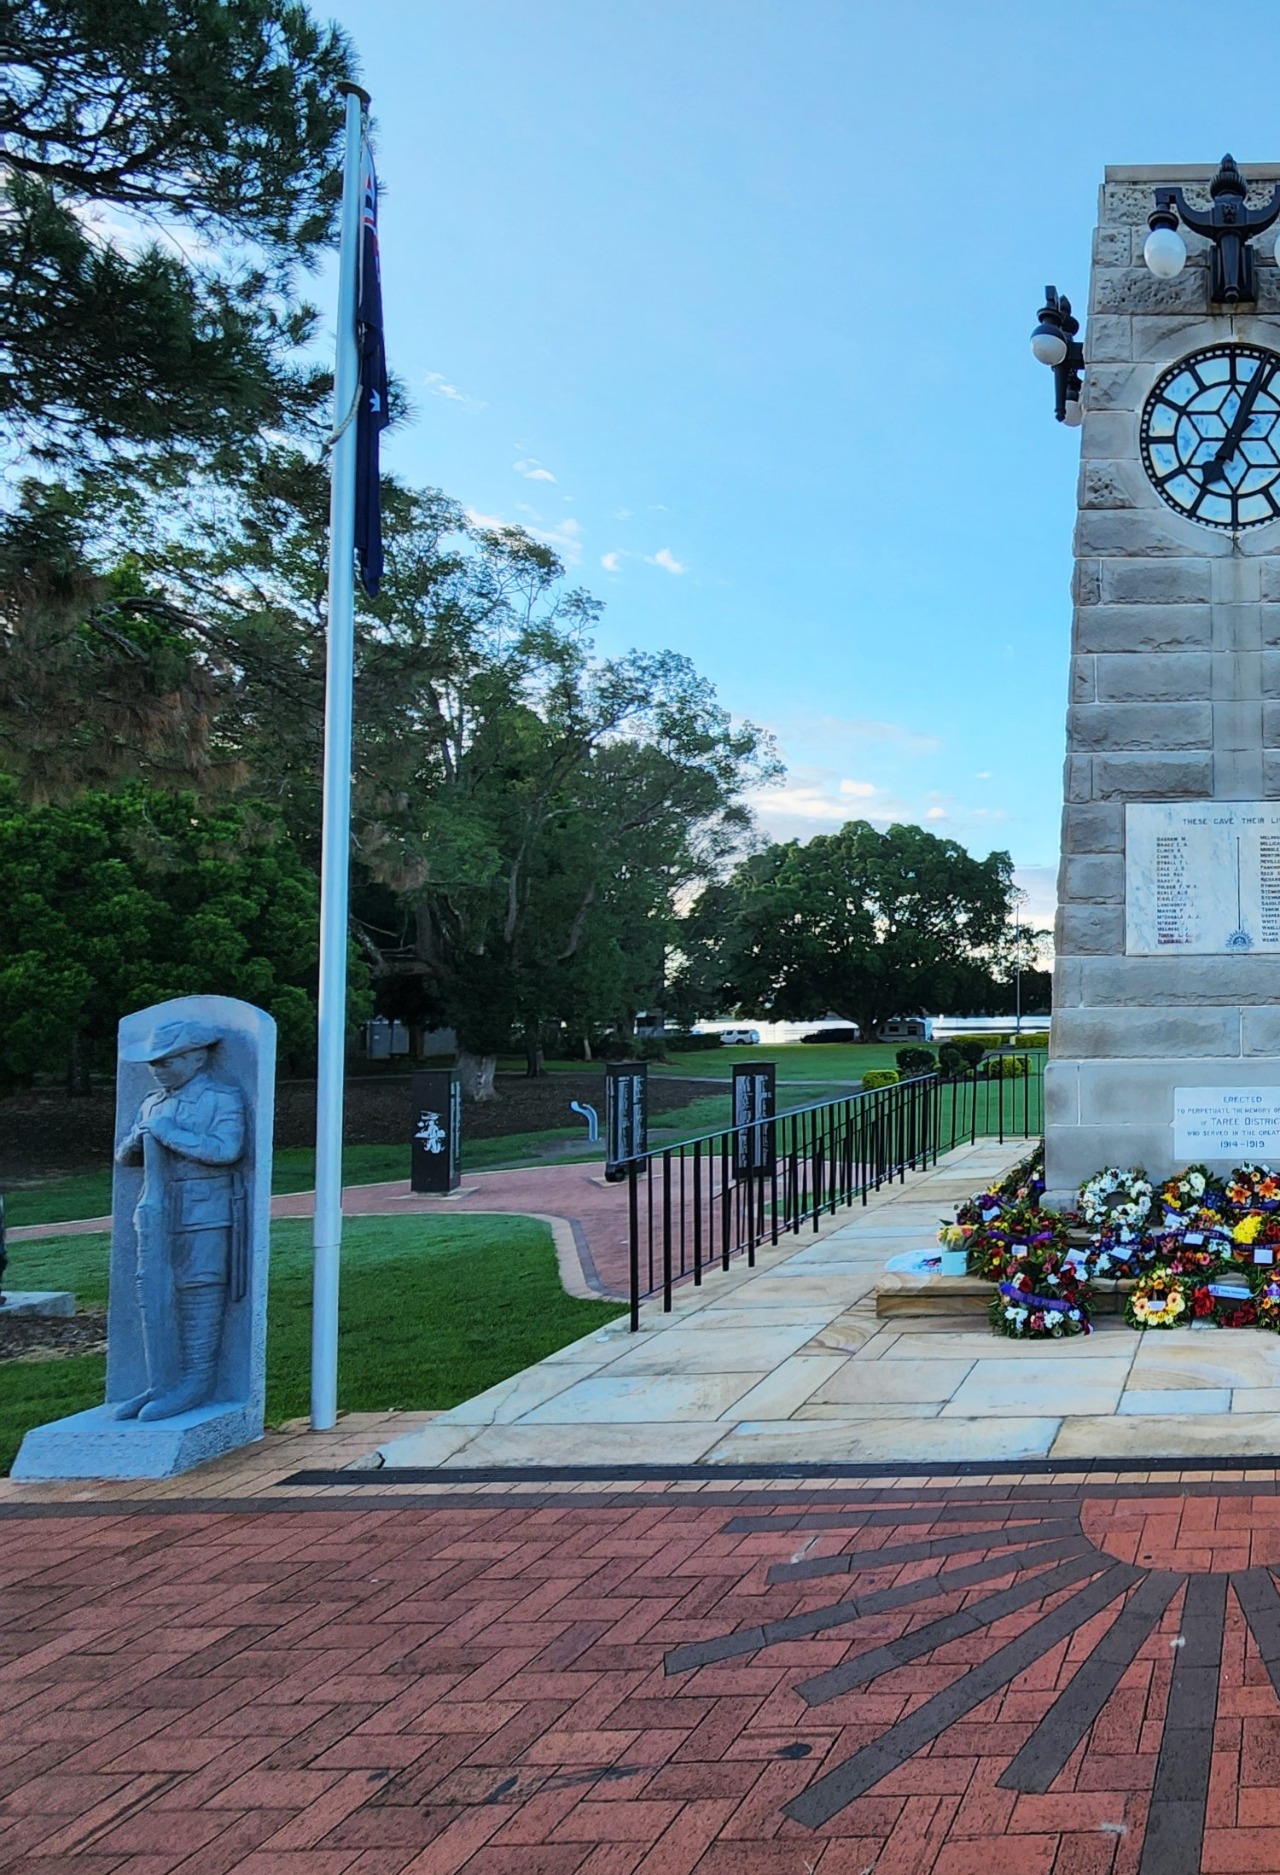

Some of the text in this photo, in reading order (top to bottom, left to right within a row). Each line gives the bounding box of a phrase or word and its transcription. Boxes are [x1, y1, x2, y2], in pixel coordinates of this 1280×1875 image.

[1213, 817, 1235, 825] GAVE
[1223, 1096, 1263, 1104] ERECTED
[1187, 1107, 1230, 1115] PERPETUATE
[1210, 1117, 1240, 1126] TAREE
